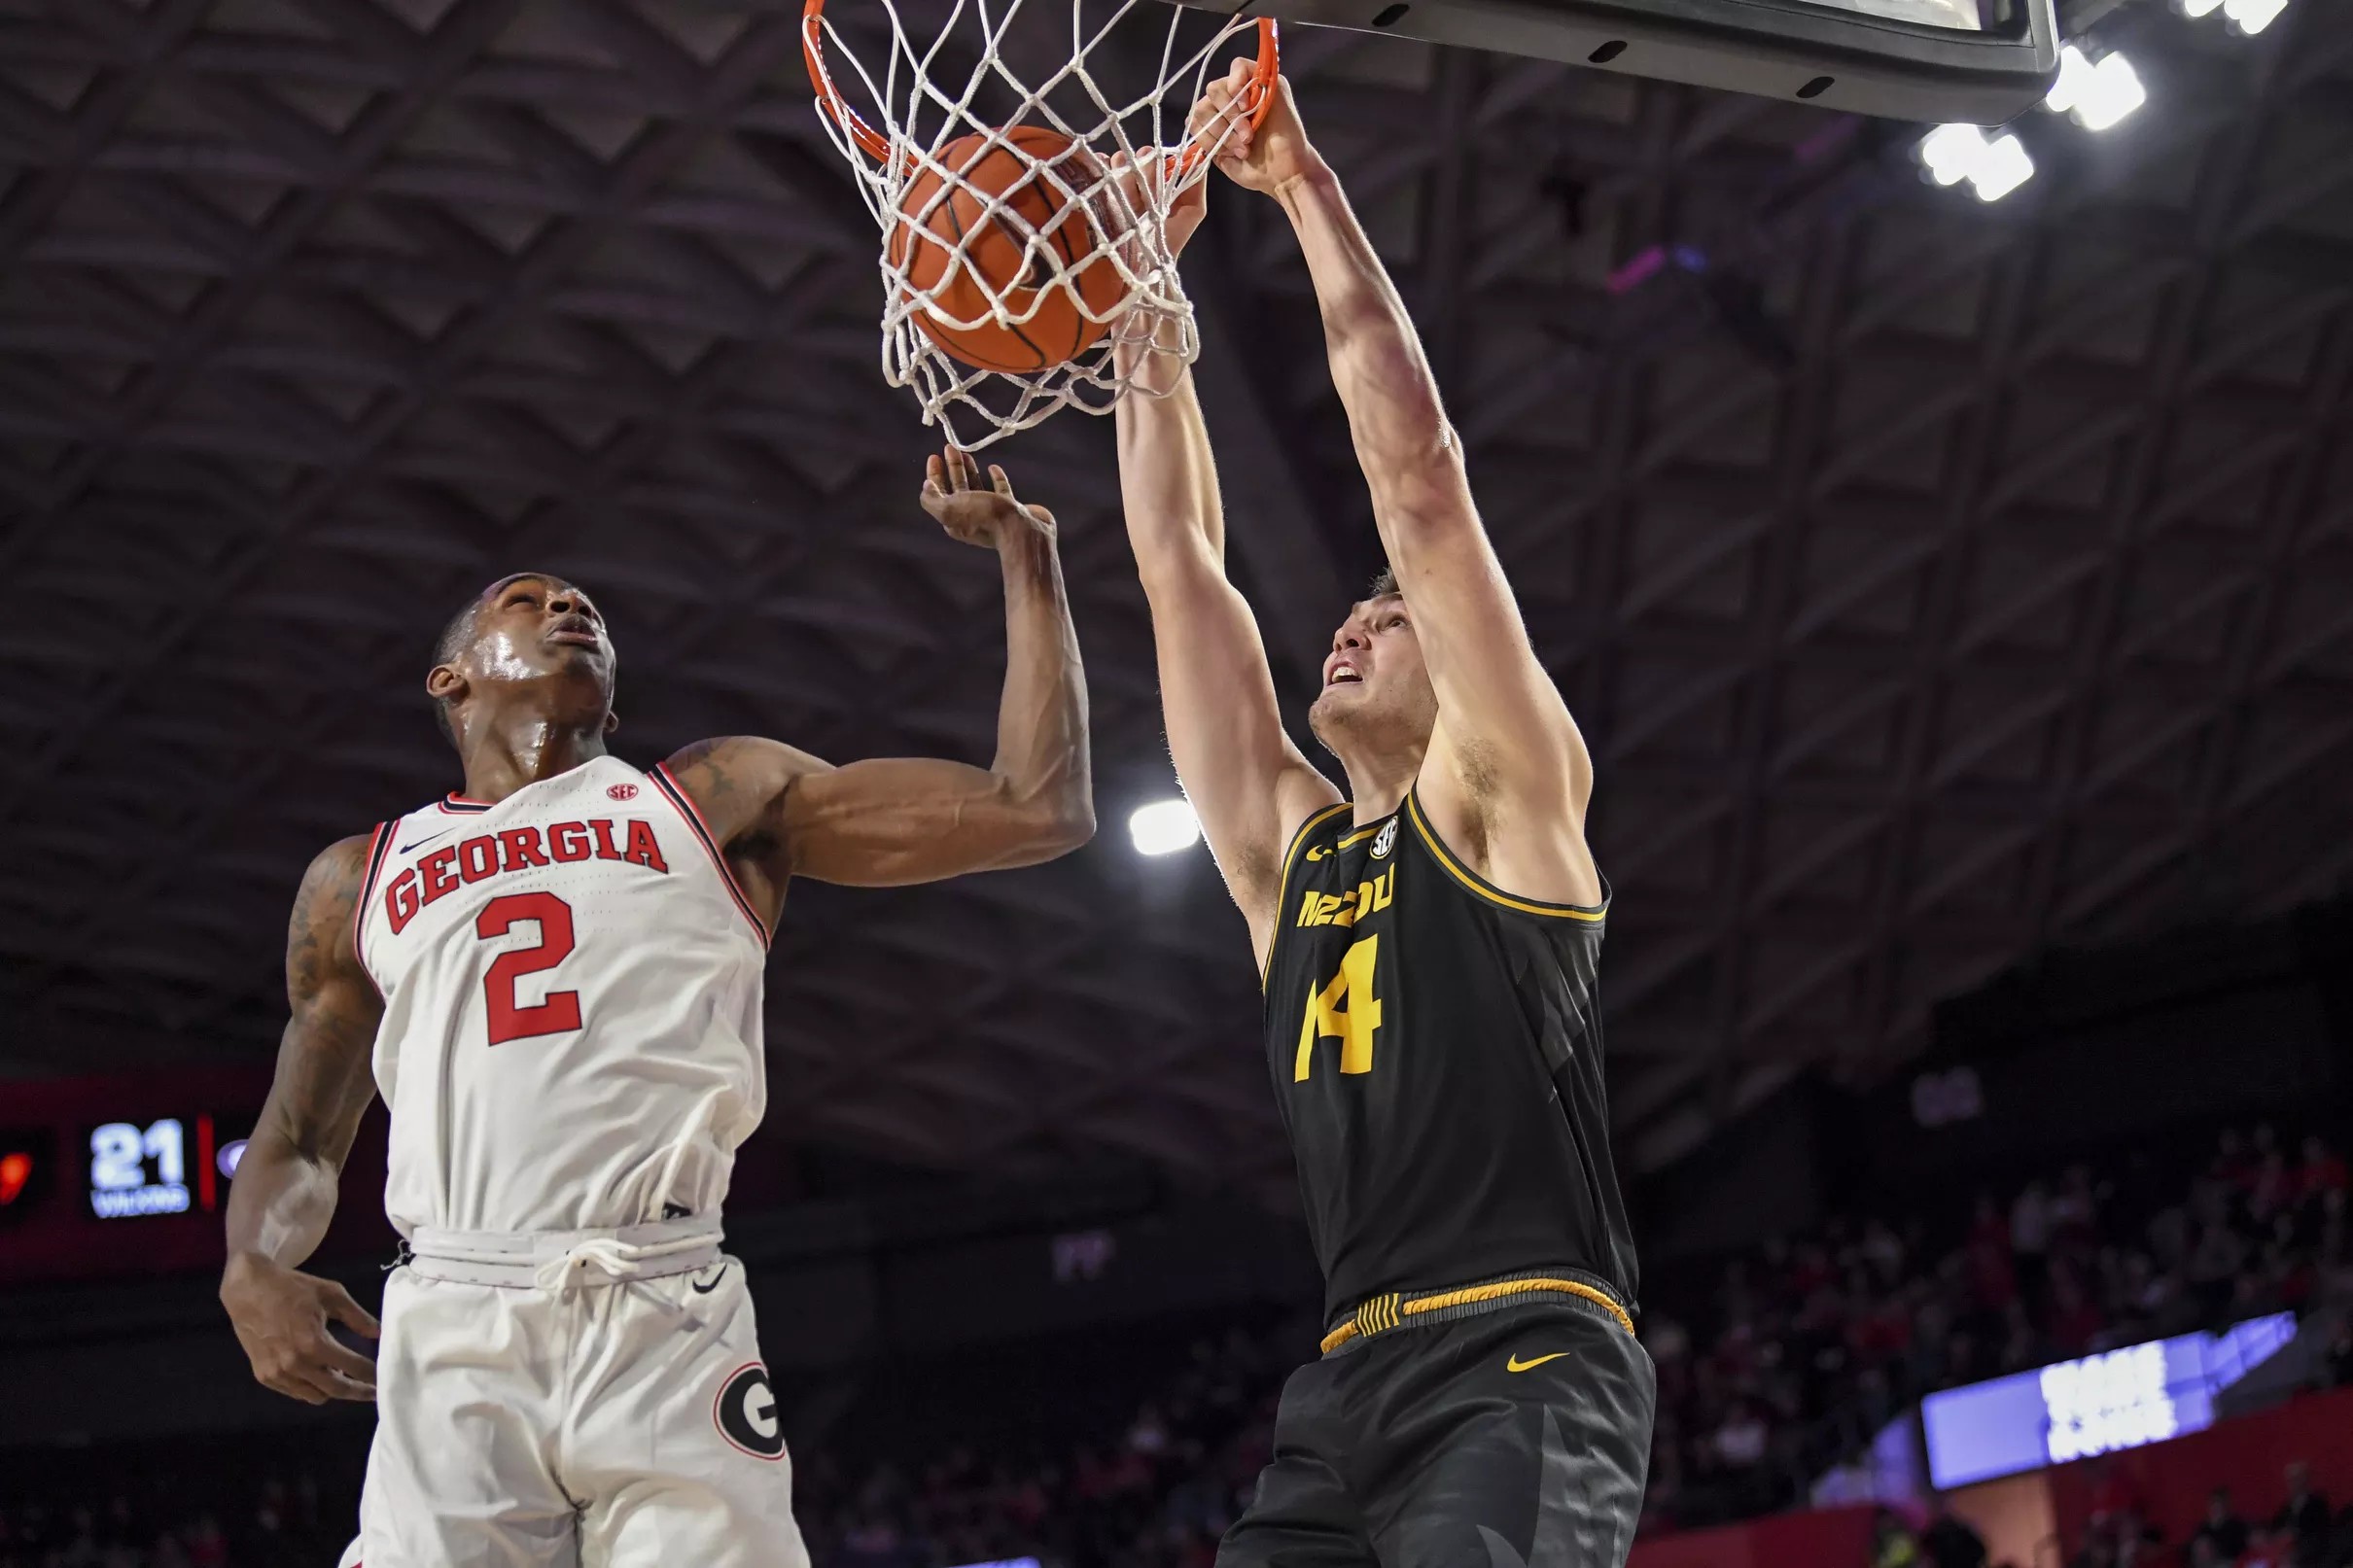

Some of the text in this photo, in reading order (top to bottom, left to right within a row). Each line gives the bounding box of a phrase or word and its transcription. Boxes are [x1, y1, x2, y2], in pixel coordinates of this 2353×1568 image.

[609, 784, 635, 799] SEC
[1371, 818, 1397, 856] SEC
[385, 819, 669, 936] GEORGIA
[475, 890, 582, 1047] 2
[90, 1119, 184, 1190] 21
